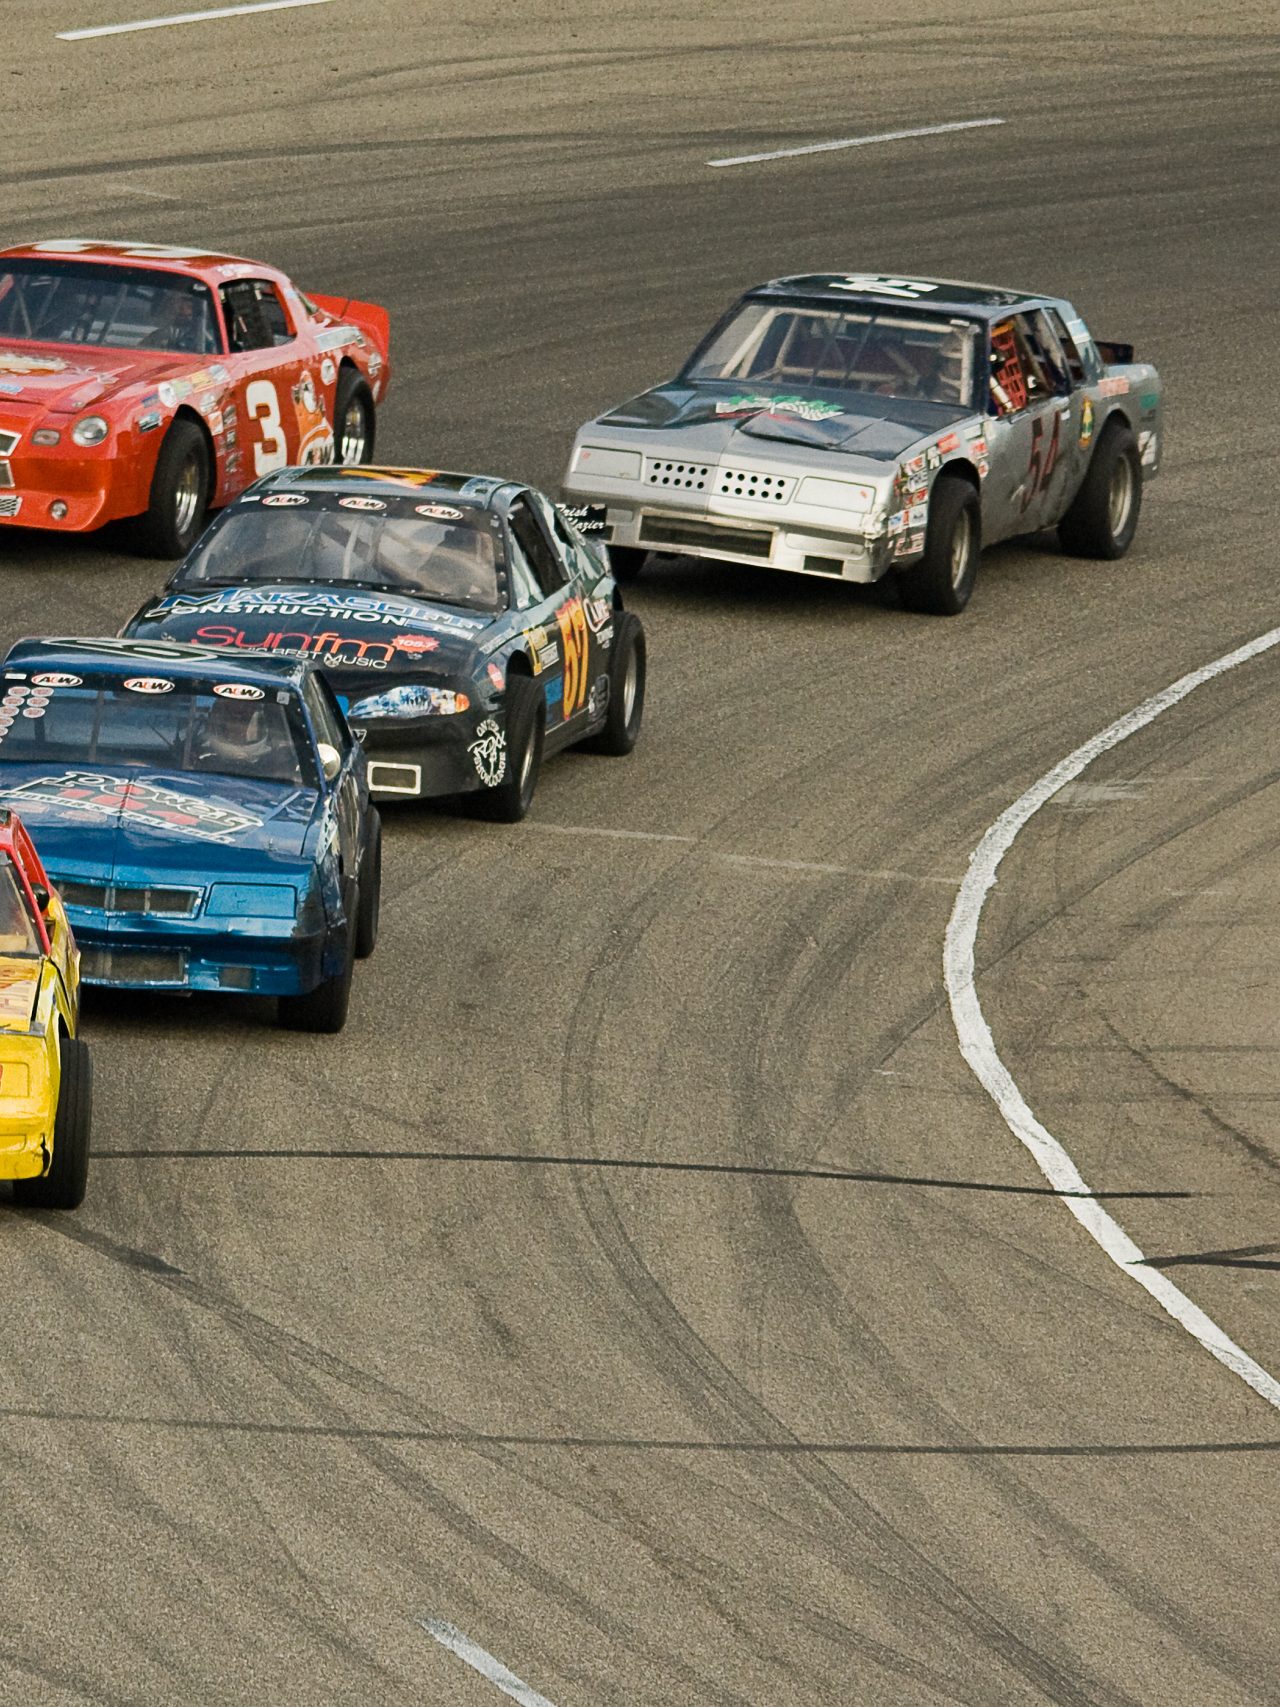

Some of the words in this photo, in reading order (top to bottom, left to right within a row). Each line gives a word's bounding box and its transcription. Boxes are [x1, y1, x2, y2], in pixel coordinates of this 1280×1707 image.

[246, 380, 288, 477] 3
[567, 517, 605, 533] lazier
[144, 602, 408, 628] CONSTRUCTION
[324, 652, 388, 669] MUSIC
